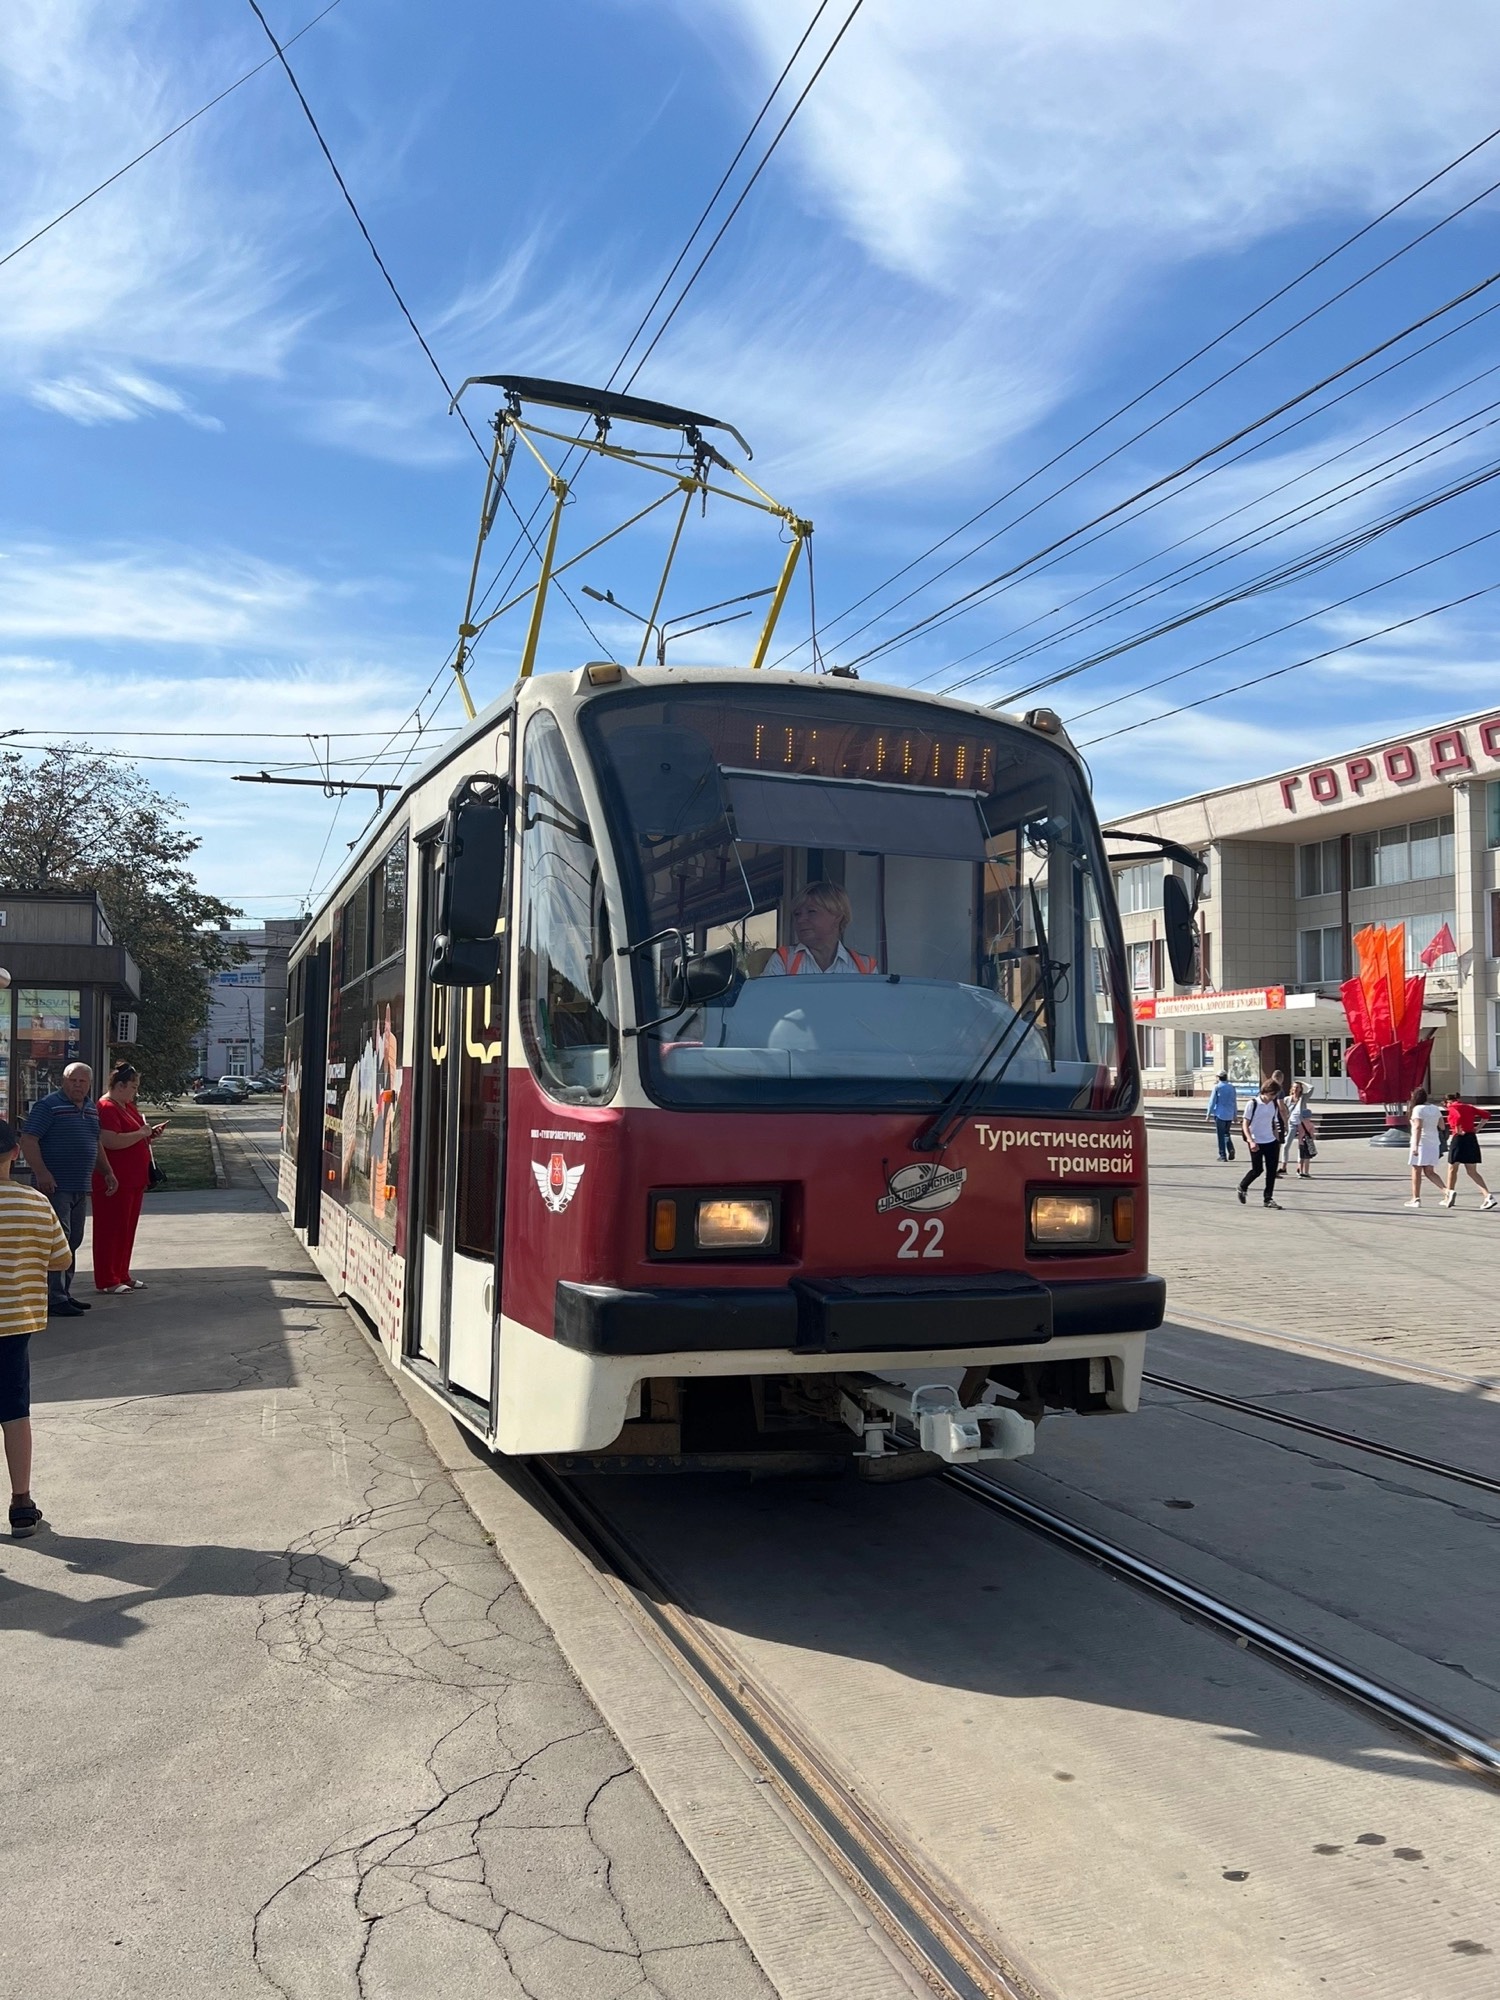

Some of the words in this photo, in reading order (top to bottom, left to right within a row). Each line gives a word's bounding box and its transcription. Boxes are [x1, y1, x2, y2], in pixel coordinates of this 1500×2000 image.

[974, 1123, 1133, 1151] Туристический
[1047, 1153, 1133, 1178] трамвай
[897, 1218, 944, 1259] 22
